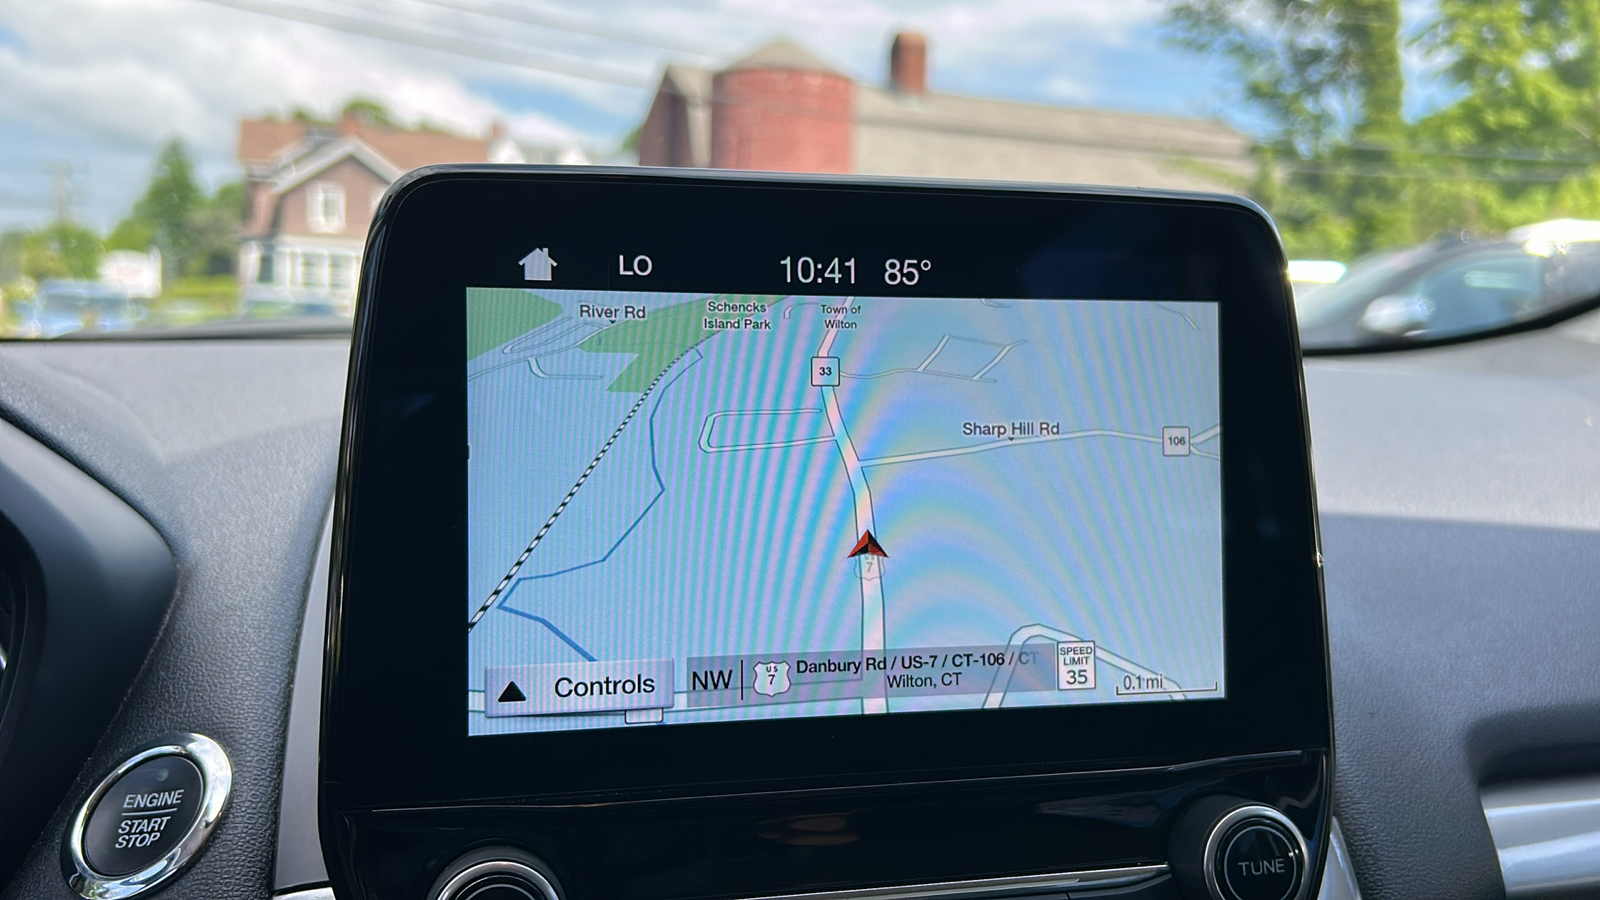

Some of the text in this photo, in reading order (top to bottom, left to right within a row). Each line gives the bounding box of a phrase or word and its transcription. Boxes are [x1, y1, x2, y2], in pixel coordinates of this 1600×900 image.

[618, 255, 653, 277] LO
[780, 257, 857, 285] 10:41
[579, 305, 646, 320] River Rd
[707, 301, 767, 315] Schencks
[820, 304, 862, 316] Town of
[704, 318, 772, 332] Island Park
[824, 319, 858, 331] Wilton
[818, 366, 833, 377] 33
[962, 422, 1060, 438] Sharp Hill Rd
[1167, 436, 1187, 447] 106
[866, 562, 873, 574] 7
[1060, 646, 1093, 656] SPEED
[795, 657, 862, 676] Danbury
[866, 655, 887, 672] Rd
[901, 654, 938, 670] US-7
[951, 652, 1005, 668] CT-106
[1018, 650, 1039, 665] CT
[1063, 656, 1090, 666] LIMIT
[692, 669, 733, 692] NW
[767, 674, 776, 687] 7
[886, 672, 963, 691] Wilton, CT
[1066, 669, 1088, 685] 35
[1124, 674, 1164, 691] 0.1 mi
[554, 674, 656, 698] Controls
[123, 789, 184, 808] ENGINE
[118, 816, 171, 834] START
[115, 832, 161, 848] STOP
[1237, 858, 1286, 877] TUNE
